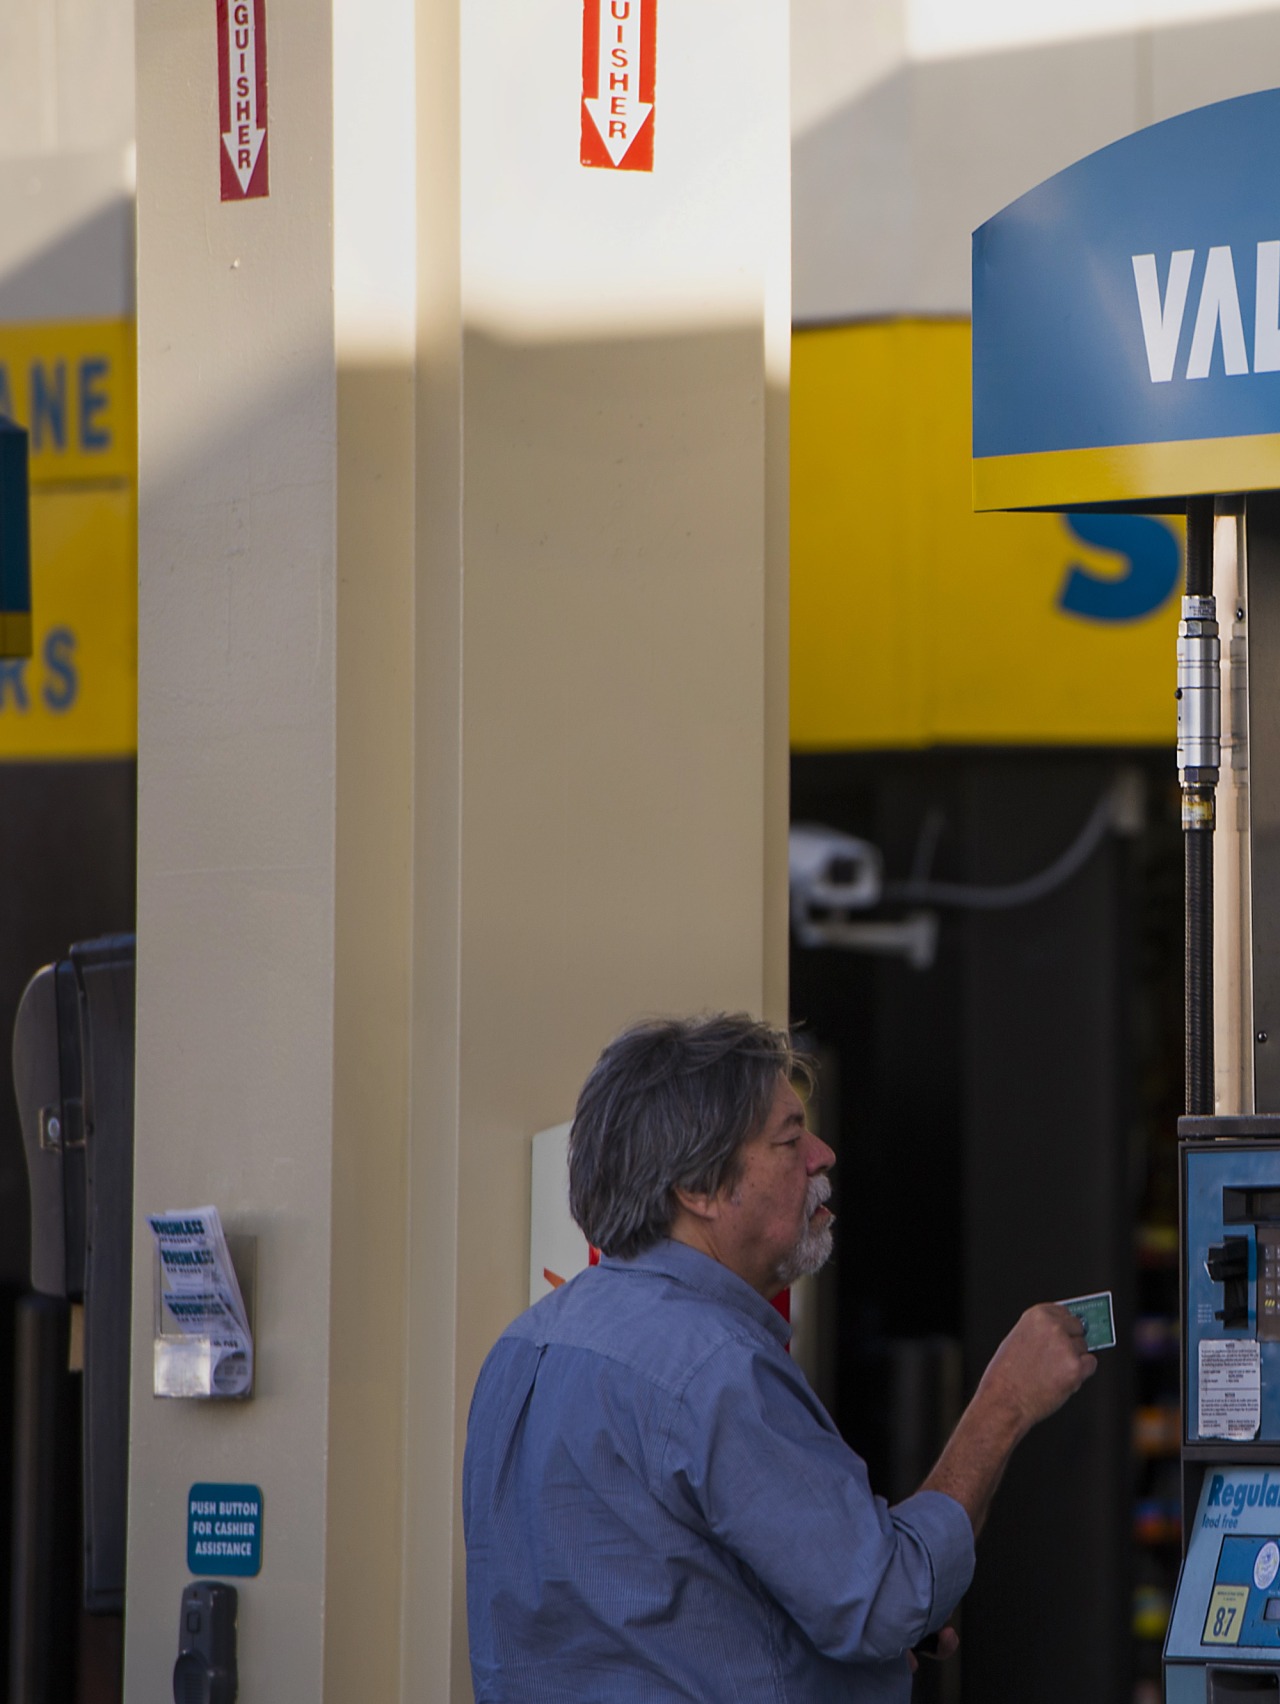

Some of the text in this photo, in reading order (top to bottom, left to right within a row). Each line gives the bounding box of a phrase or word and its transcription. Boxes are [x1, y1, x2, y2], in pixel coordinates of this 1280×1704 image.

[609, 0, 630, 139] UISHER
[234, 0, 252, 169] GUISHER
[191, 1501, 258, 1516] PUSH BUTTON
[193, 1521, 255, 1536] FOR CASHIER
[1201, 1513, 1238, 1529] lead free
[195, 1541, 252, 1556] ASSISTANCE
[1213, 1607, 1236, 1637] 87
